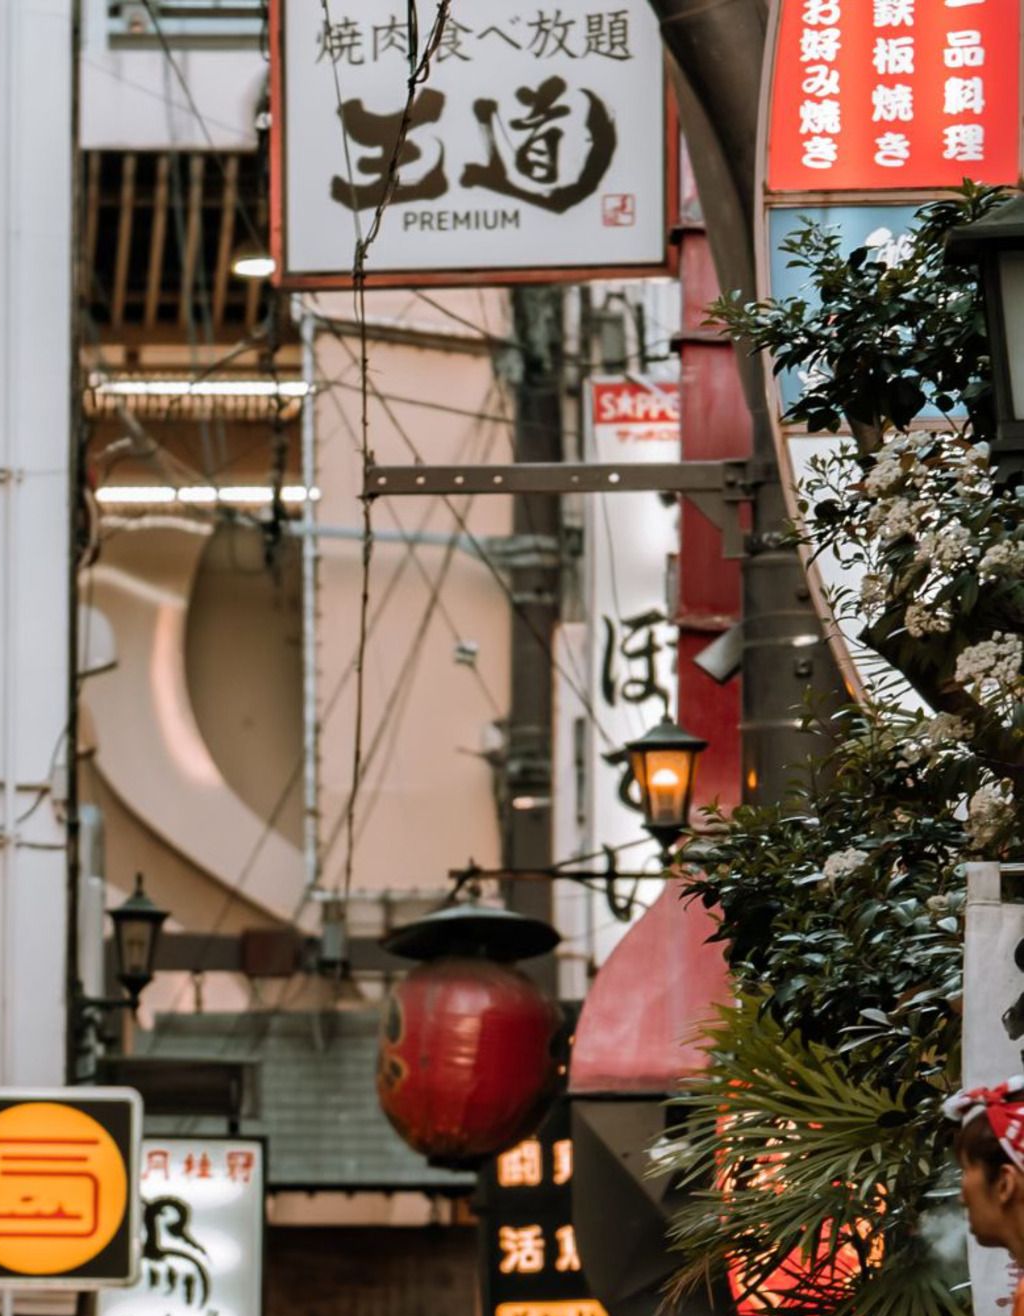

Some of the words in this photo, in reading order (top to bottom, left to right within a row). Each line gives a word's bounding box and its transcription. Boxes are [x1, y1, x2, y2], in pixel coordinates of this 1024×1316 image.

[316, 10, 634, 66] 焼肉食べ放題
[403, 209, 521, 231] PREMIUM
